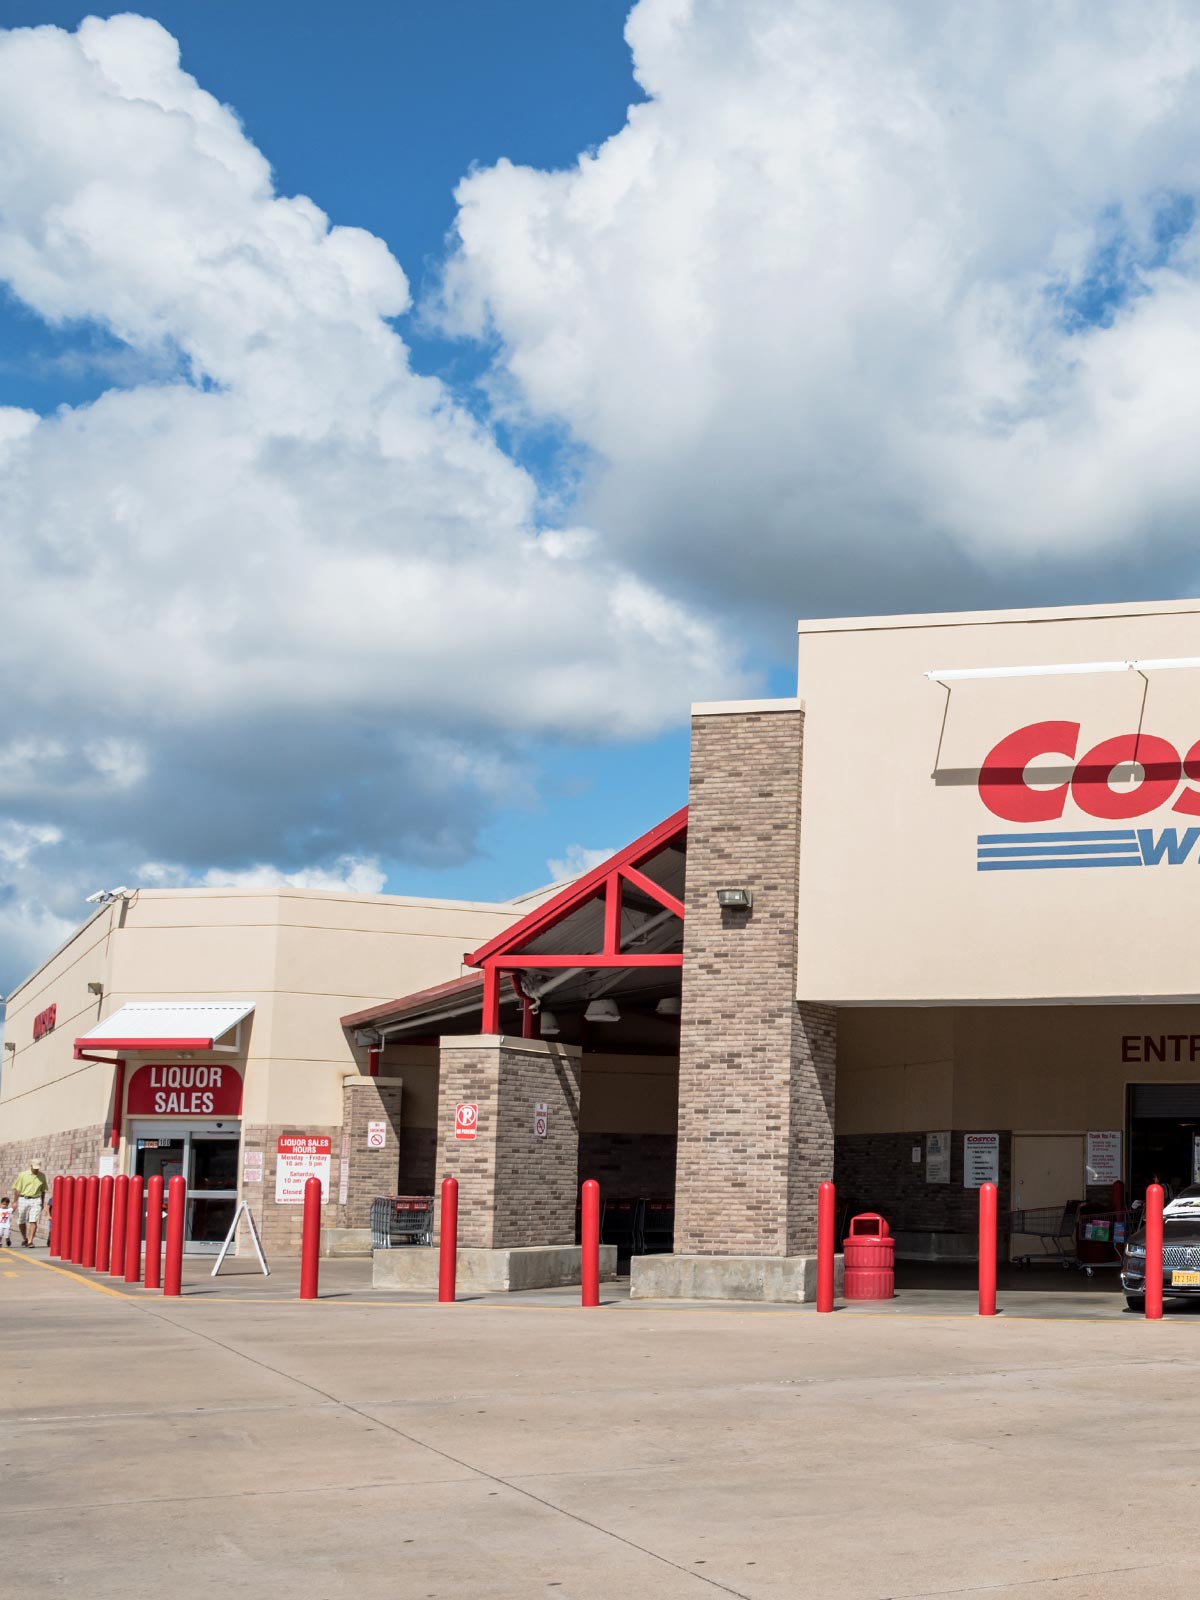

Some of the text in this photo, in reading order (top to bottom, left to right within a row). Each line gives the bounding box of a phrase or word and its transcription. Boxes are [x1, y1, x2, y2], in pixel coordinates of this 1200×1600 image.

[150, 1067, 223, 1089] LIQUOR
[154, 1092, 214, 1113] SALES
[292, 1146, 317, 1154] HOURS
[307, 1139, 329, 1147] SALES
